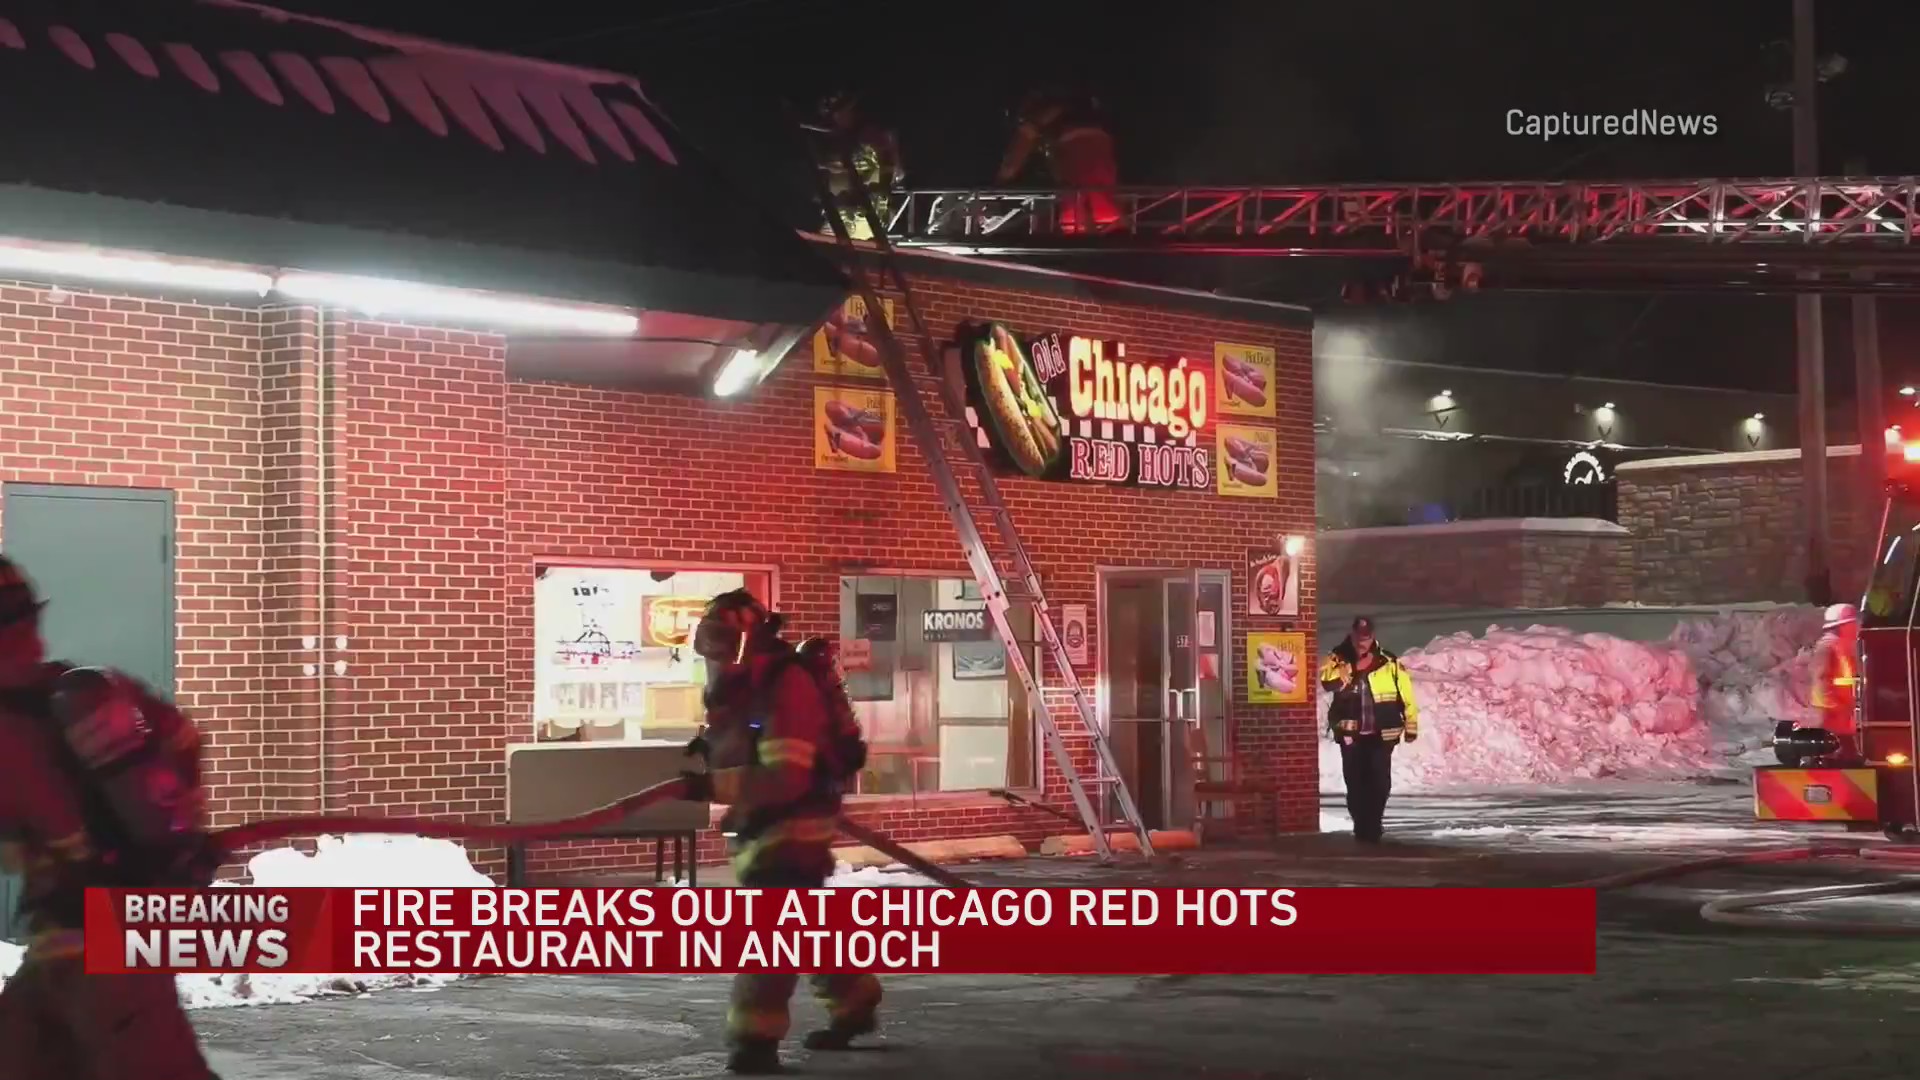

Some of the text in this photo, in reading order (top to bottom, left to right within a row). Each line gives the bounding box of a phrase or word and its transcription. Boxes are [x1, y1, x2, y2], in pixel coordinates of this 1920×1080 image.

[1031, 333, 1067, 384] Old
[1069, 335, 1207, 438] Chicago
[1070, 437, 1210, 488] RED HOTS
[924, 611, 984, 631] KRONOS
